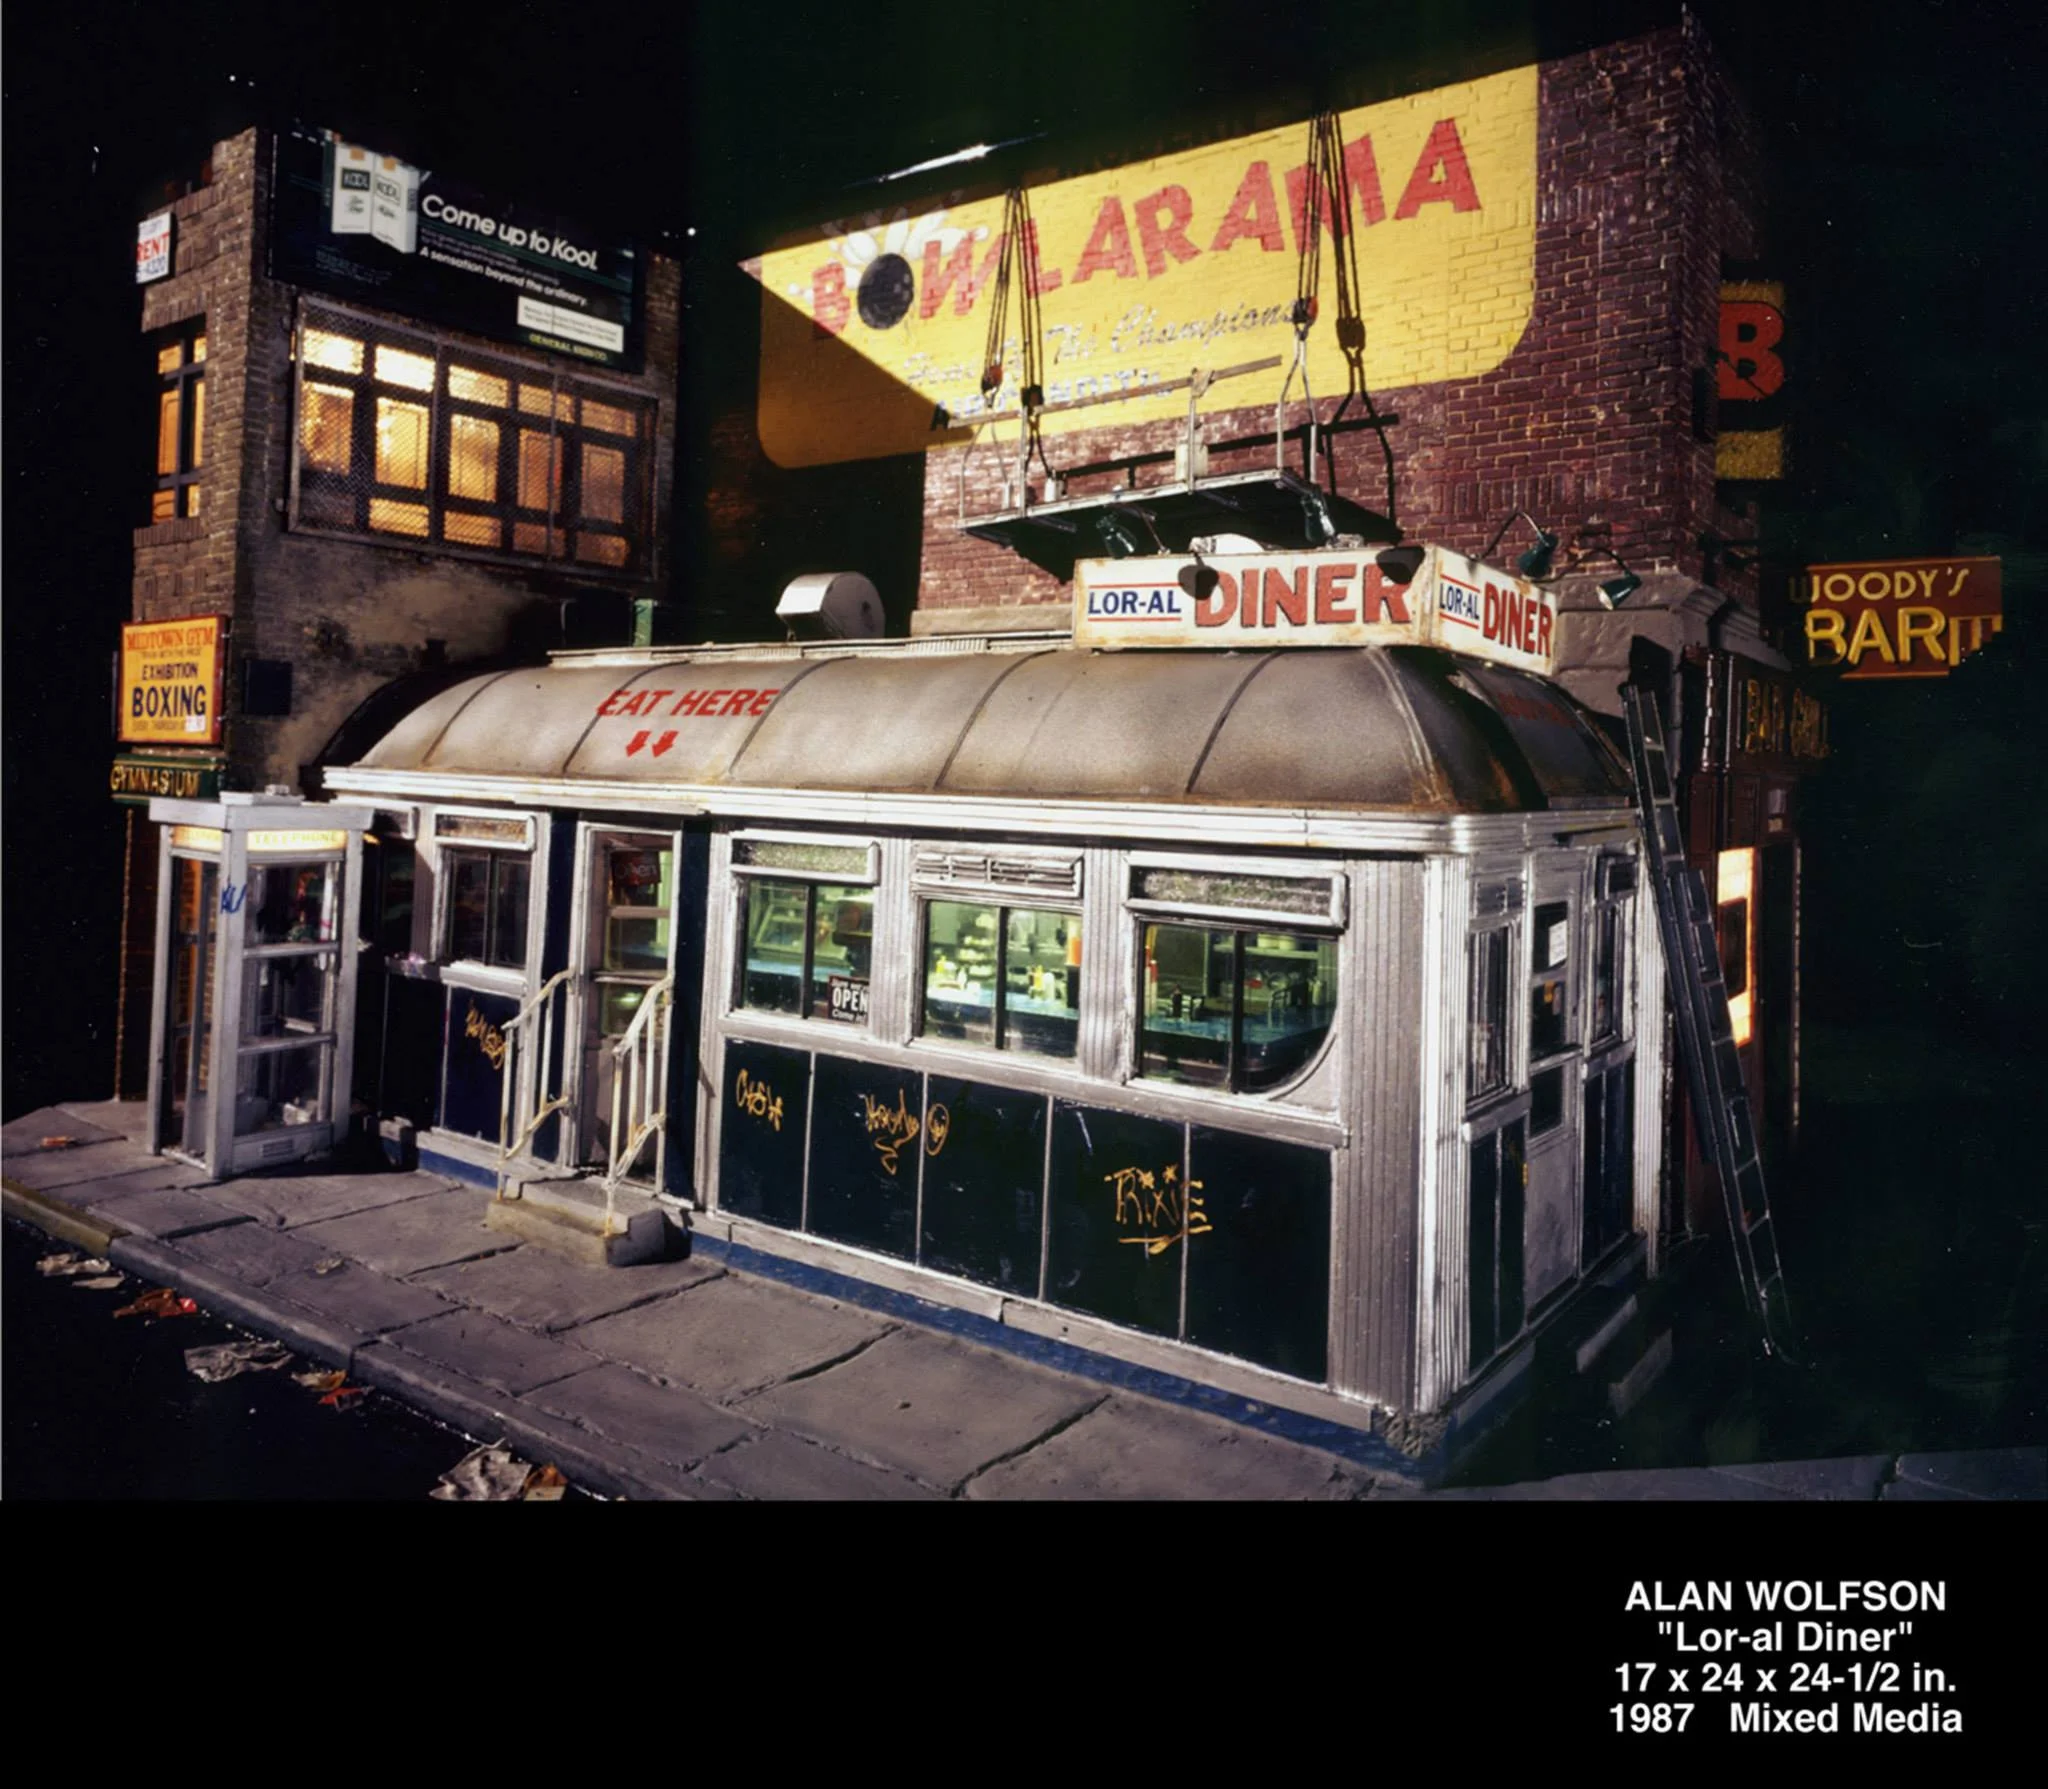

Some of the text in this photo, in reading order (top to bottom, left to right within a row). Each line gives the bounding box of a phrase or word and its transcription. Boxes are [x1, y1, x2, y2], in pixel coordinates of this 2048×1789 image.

[421, 194, 496, 236] Come
[498, 222, 528, 247] up
[528, 230, 550, 254] to
[812, 117, 1482, 338] BOWLARAMA
[419, 246, 430, 258] A
[430, 250, 484, 273] sensation
[485, 266, 525, 289] beyond
[525, 278, 544, 294] the
[1087, 563, 1412, 628] LOR-AL DINER
[1438, 581, 1553, 658] LOR-AL DINER
[142, 662, 197, 681] EXHIBITION
[132, 684, 207, 718] BOXING
[596, 689, 781, 717] EAT HERE
[110, 765, 200, 797] GYMNASIUM
[832, 986, 868, 1012] OPEN
